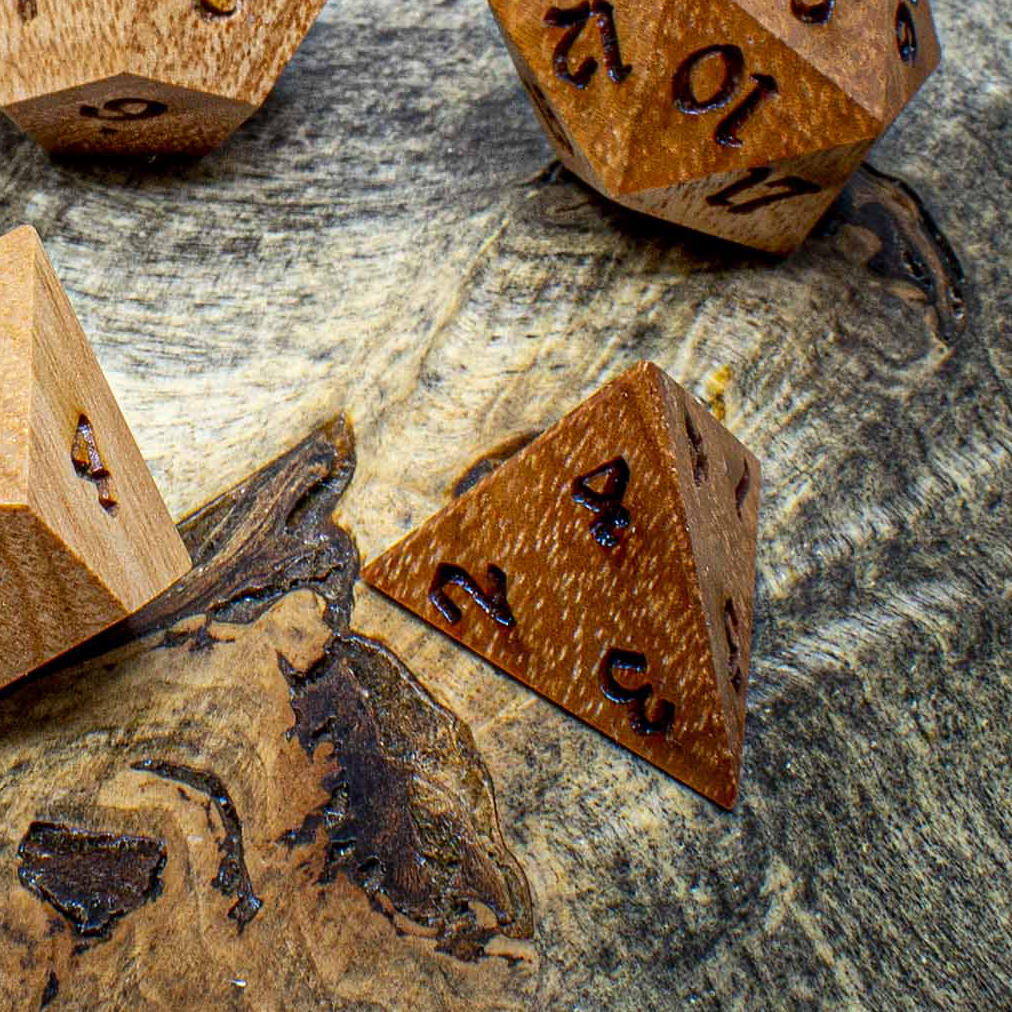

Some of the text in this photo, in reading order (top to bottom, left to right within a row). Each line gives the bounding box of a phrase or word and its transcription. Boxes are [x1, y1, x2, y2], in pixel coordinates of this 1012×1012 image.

[672, 44, 780, 148] 10
[70, 413, 119, 517] 4
[571, 455, 631, 548] 4
[598, 648, 676, 734] 3
